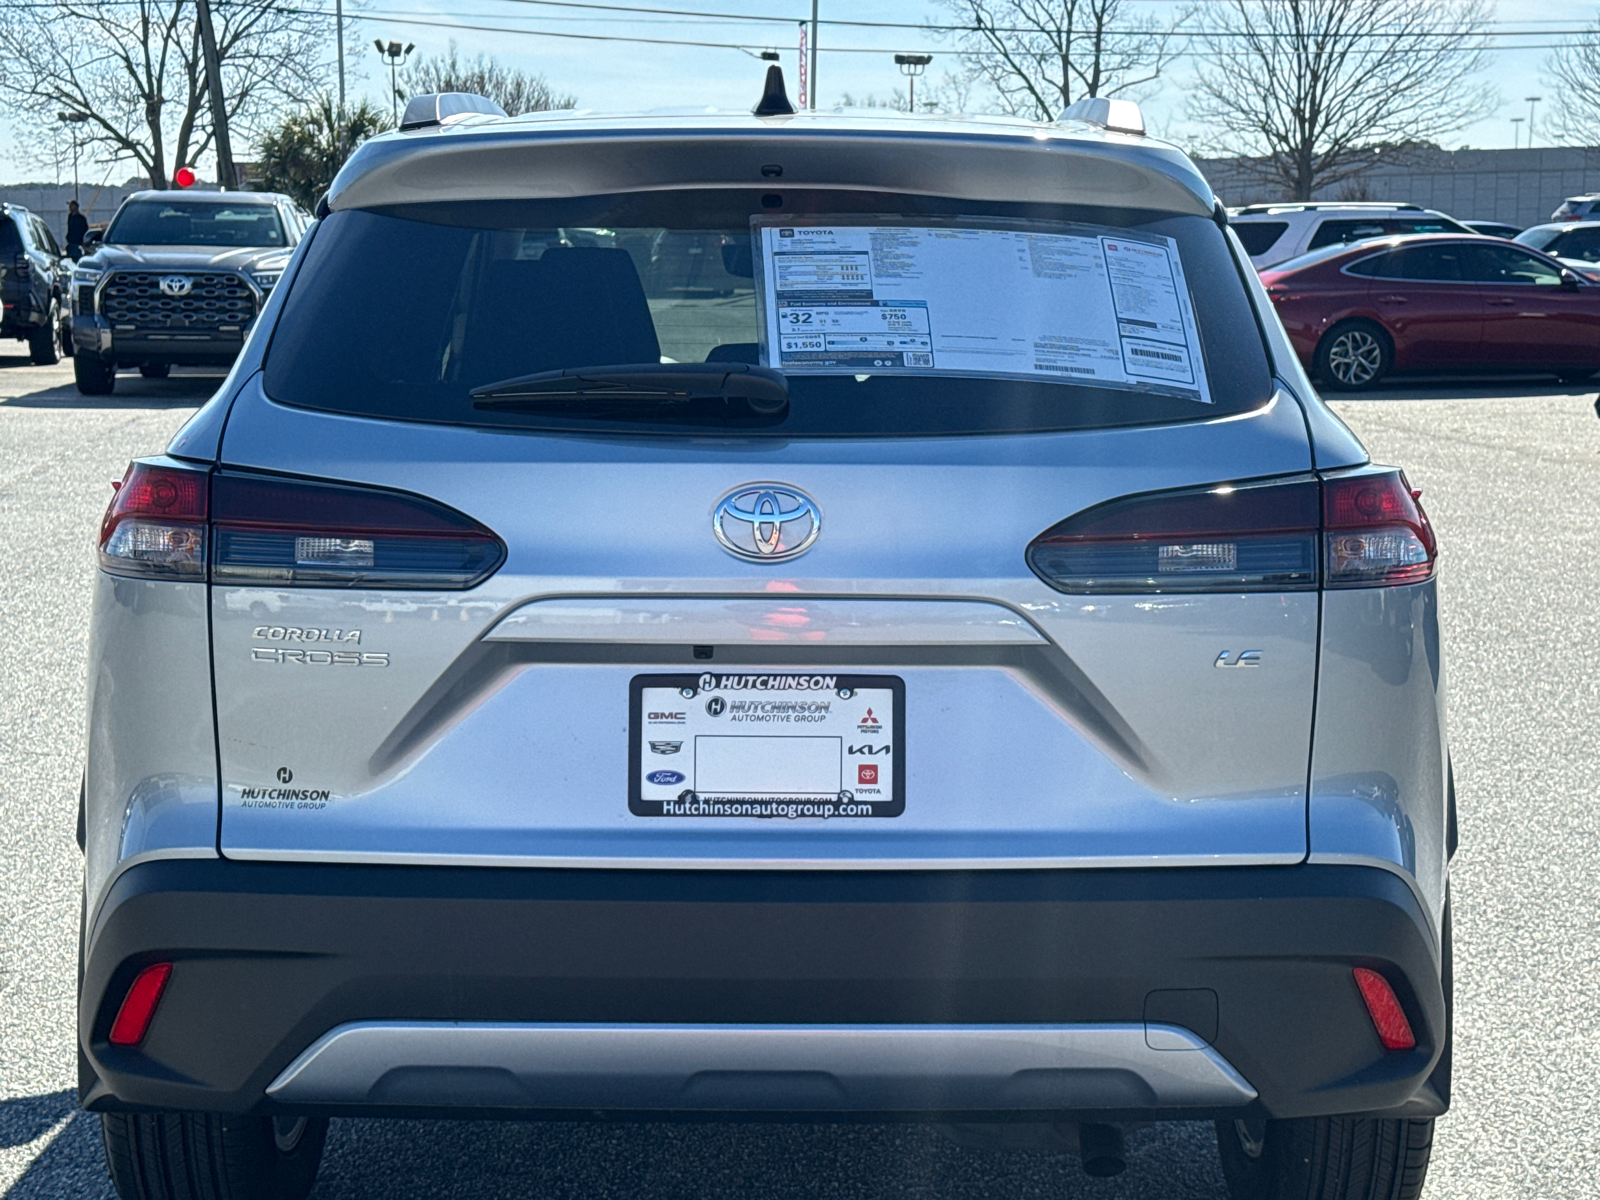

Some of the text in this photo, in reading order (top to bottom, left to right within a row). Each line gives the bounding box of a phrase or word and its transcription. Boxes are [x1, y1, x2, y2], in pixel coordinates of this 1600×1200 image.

[789, 312, 813, 325] 32
[881, 313, 907, 321] $750
[786, 341, 822, 349] $1,550
[252, 625, 362, 645] COROLLA
[251, 647, 390, 668] CROSS
[1213, 650, 1263, 668] LE
[720, 675, 837, 690] HUTCHINSON
[729, 701, 831, 714] HUTCHINSON
[648, 712, 686, 720] GMC
[730, 714, 827, 723] AUTOMOTIVE GROUP
[241, 788, 330, 801] HUTCHINSON
[241, 800, 326, 810] AUTOMOTIVE GROUP
[663, 801, 872, 818] Hutchinsonautogroup.com
